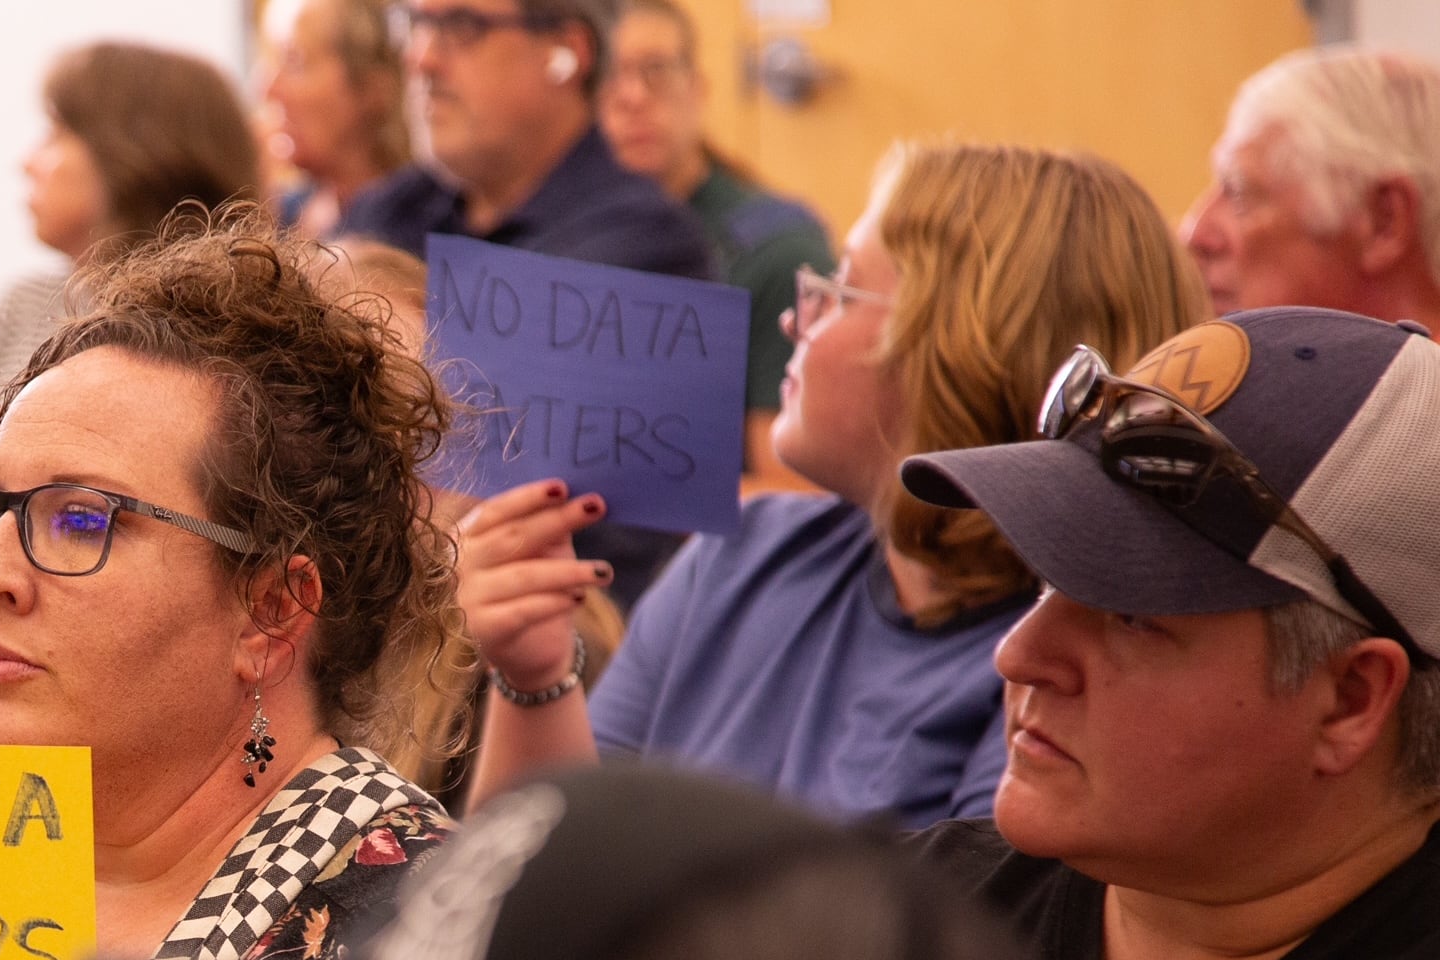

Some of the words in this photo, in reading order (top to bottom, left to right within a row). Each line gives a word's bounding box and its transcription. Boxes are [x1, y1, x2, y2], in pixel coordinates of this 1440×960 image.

[440, 258, 522, 338] NO
[550, 280, 708, 362] DATA
[452, 383, 698, 483] NTERS
